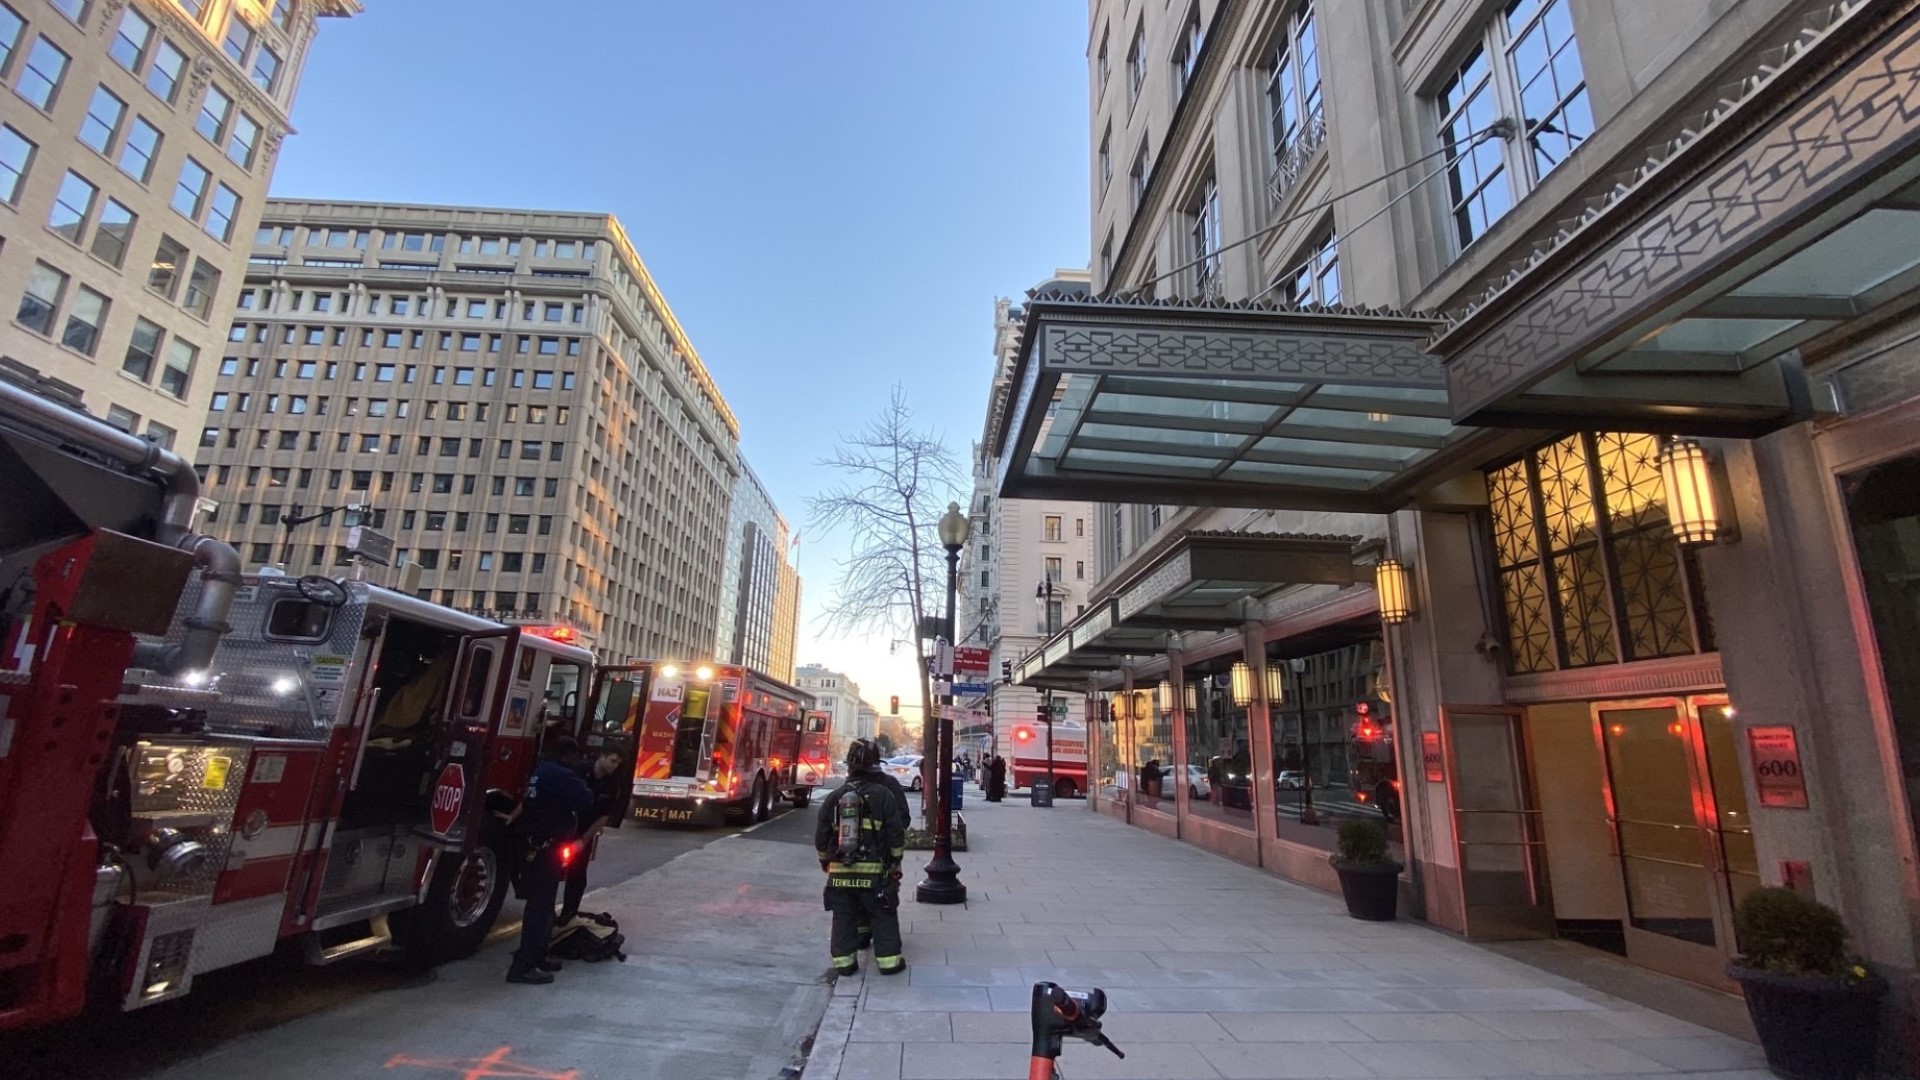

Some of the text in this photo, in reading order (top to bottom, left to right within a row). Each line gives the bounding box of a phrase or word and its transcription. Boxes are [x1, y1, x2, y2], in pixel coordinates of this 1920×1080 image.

[657, 687, 678, 698] HAZ
[1759, 759, 1797, 777] 600
[434, 785, 461, 813] STOP
[634, 807, 659, 818] HAZ
[668, 809, 693, 820] MAT
